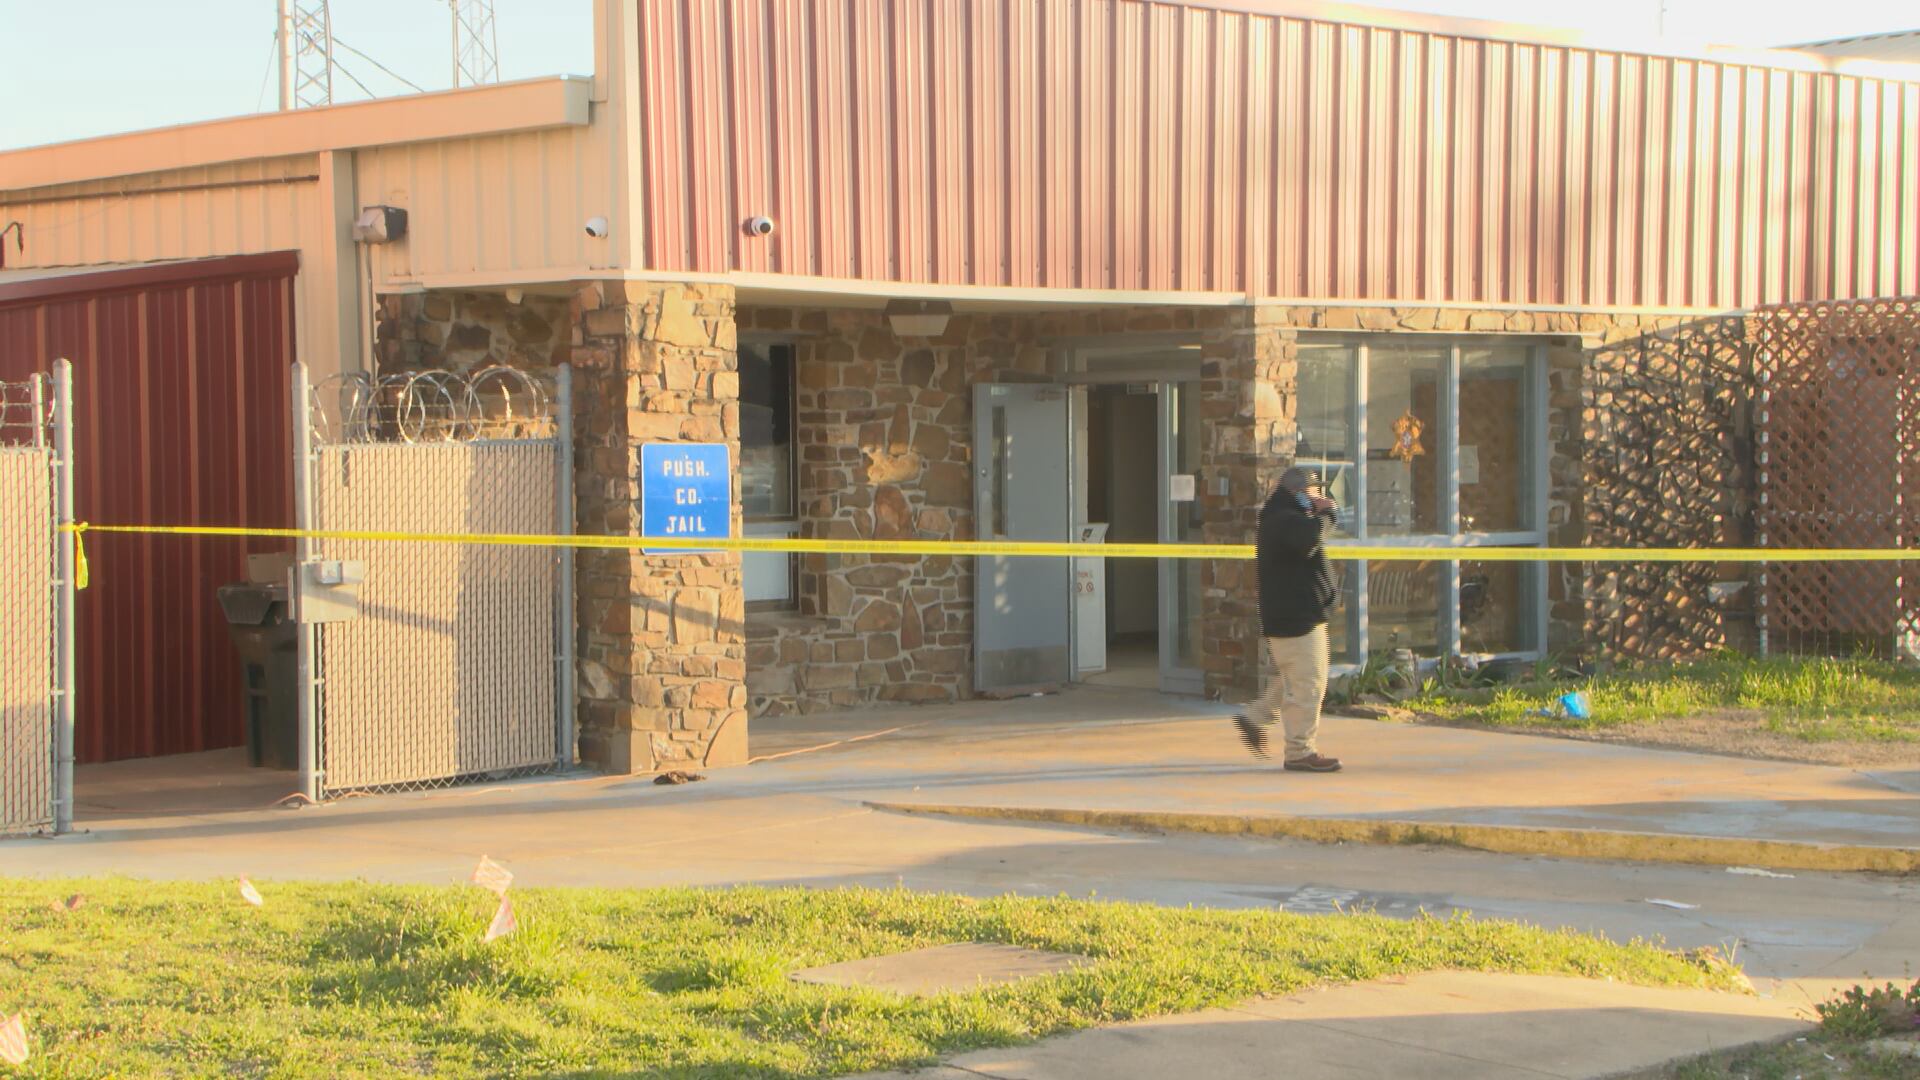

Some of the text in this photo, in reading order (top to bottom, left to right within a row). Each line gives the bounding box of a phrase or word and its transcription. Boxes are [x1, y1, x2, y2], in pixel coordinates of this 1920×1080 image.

[663, 460, 710, 477] PUSH.
[676, 488, 702, 505] CO.
[666, 516, 706, 533] JAIL
